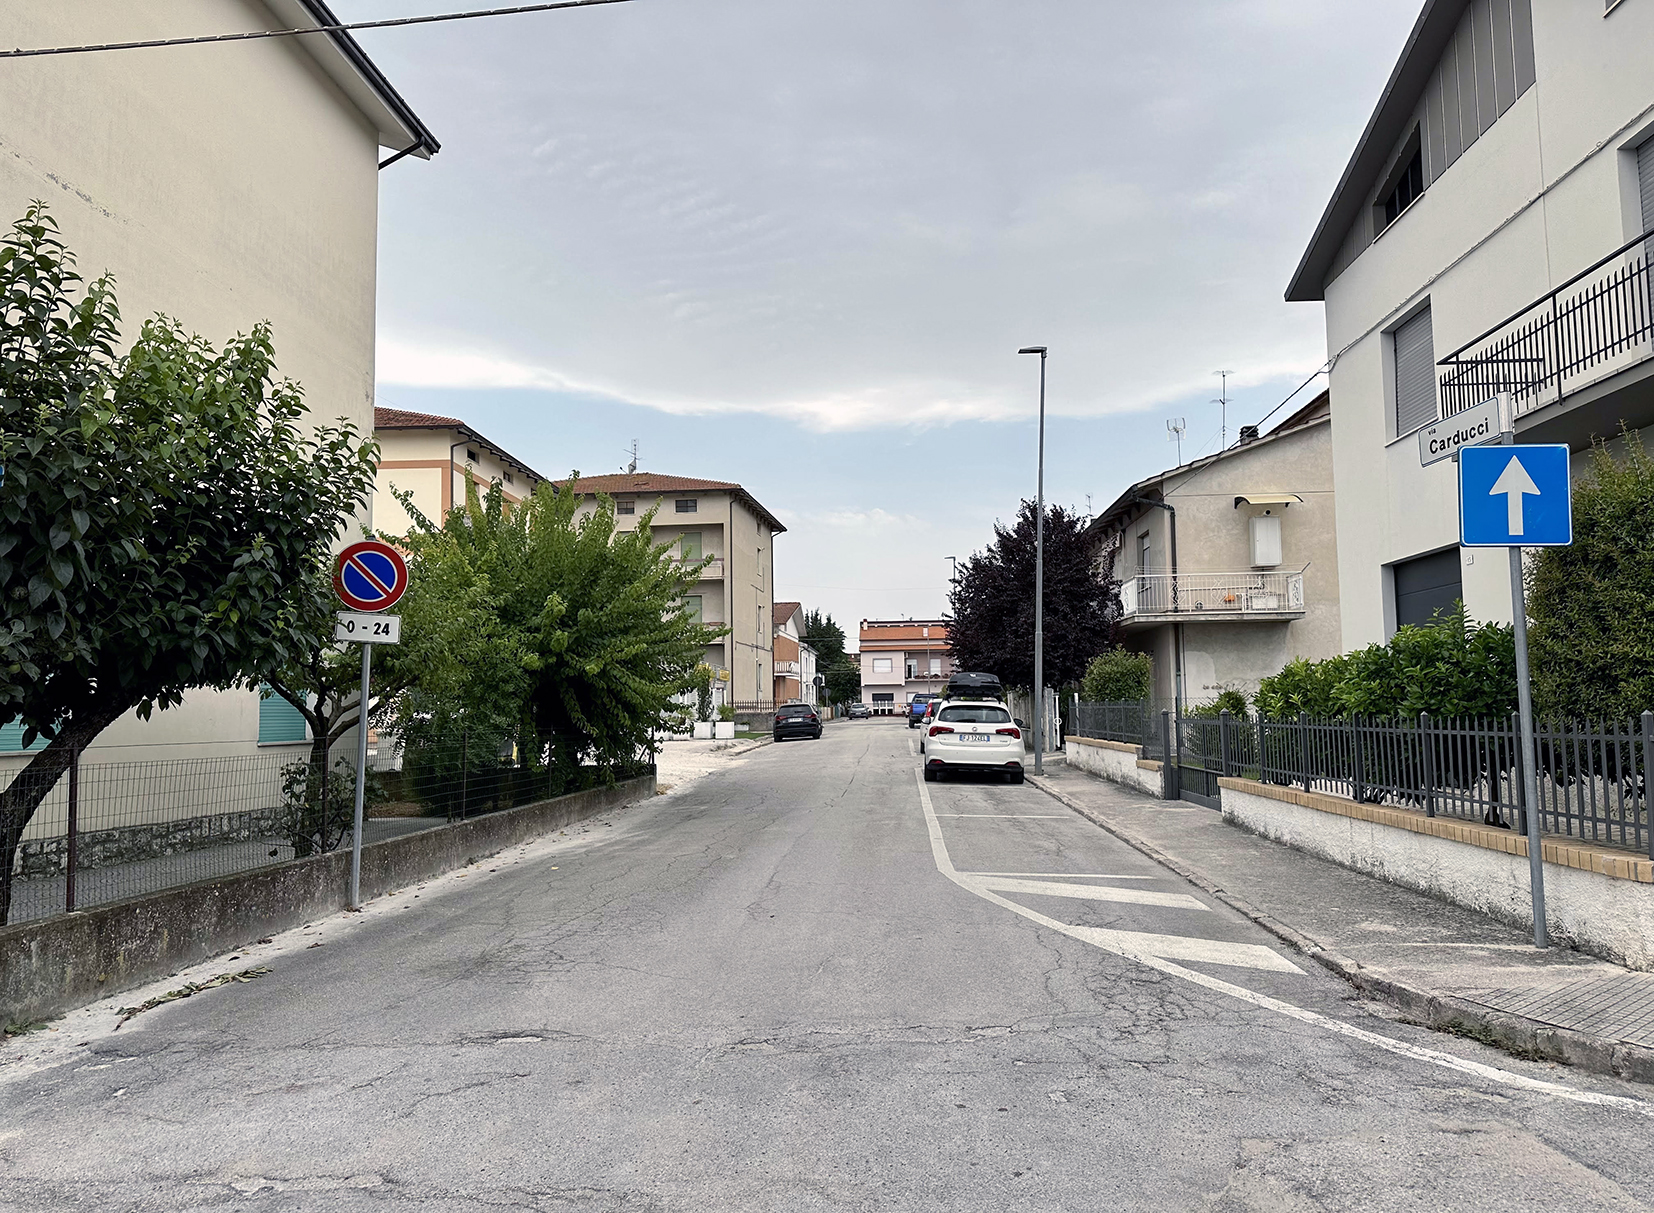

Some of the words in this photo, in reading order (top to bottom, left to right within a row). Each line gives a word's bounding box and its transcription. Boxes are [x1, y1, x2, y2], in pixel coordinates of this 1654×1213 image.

[1428, 427, 1436, 435] via
[1429, 417, 1489, 454] Carducci
[347, 620, 355, 633] 0
[373, 623, 390, 635] 24
